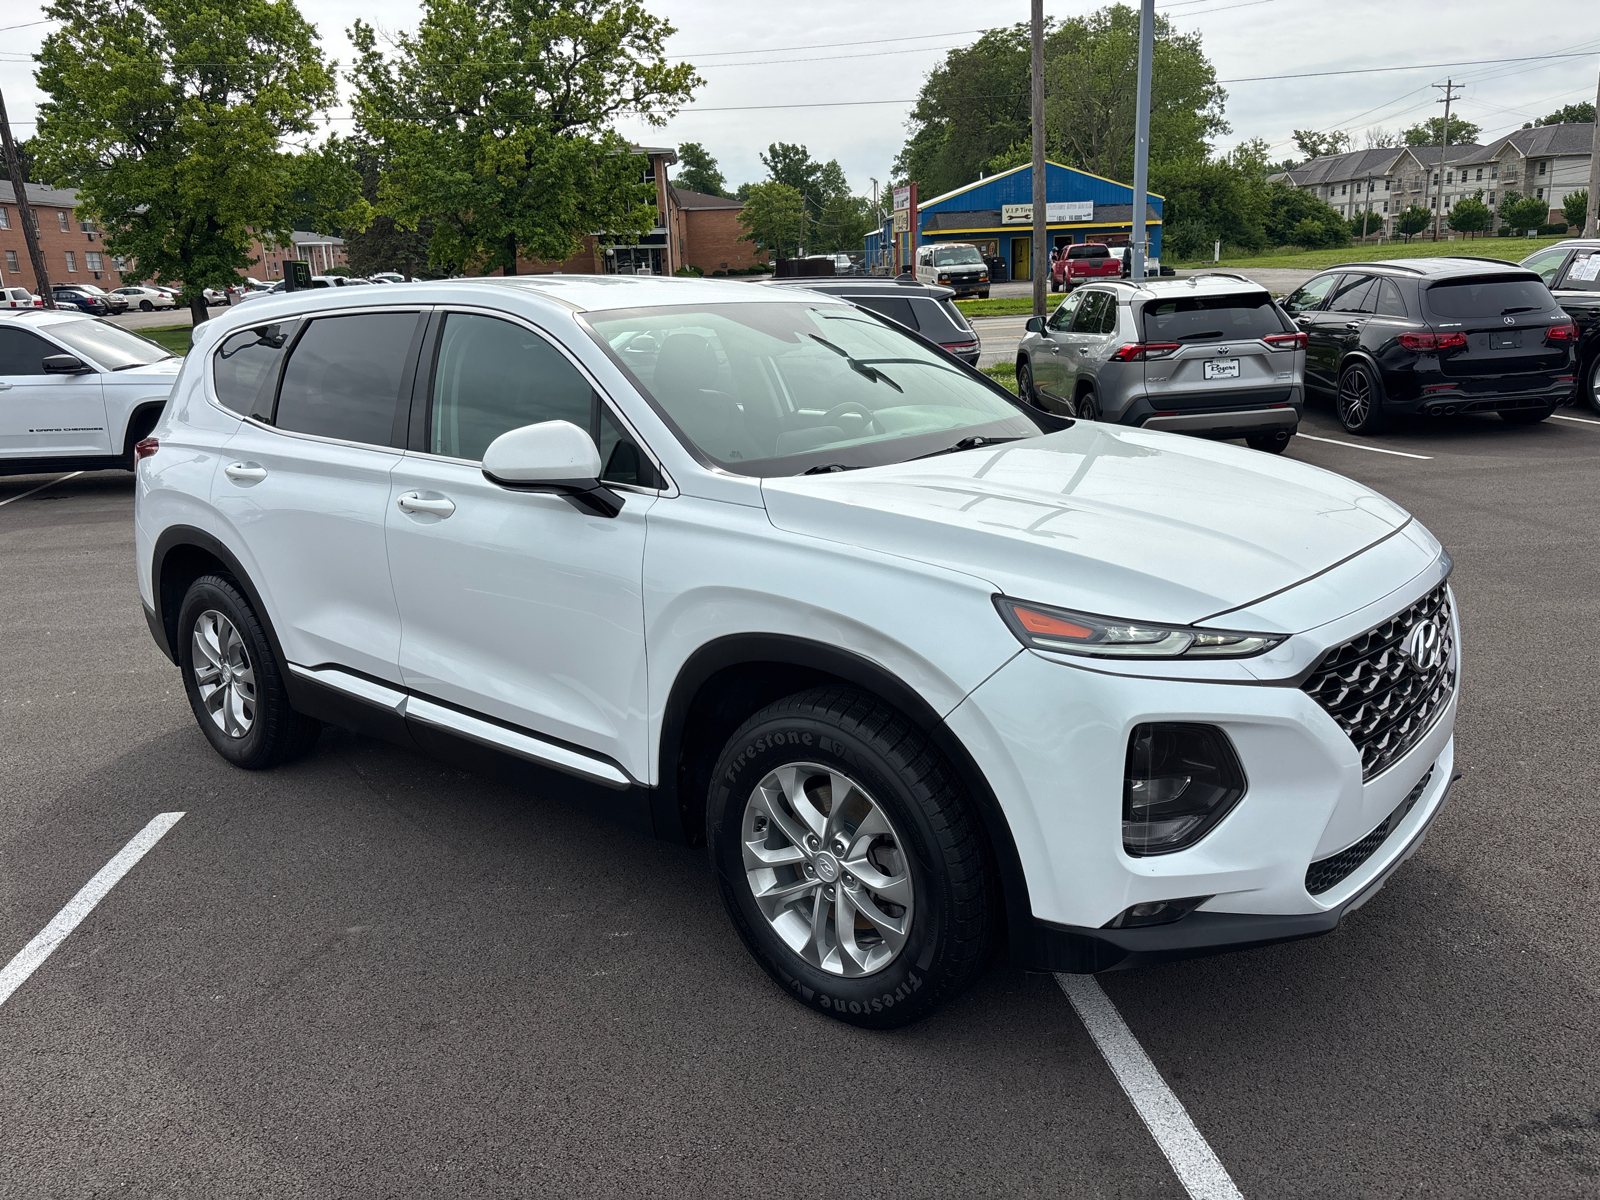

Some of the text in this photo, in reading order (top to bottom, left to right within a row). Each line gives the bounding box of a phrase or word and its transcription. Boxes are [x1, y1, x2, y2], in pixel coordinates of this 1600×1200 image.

[1207, 364, 1235, 373] Byers
[724, 731, 813, 783] Firestone
[819, 971, 923, 1015] Firestone
